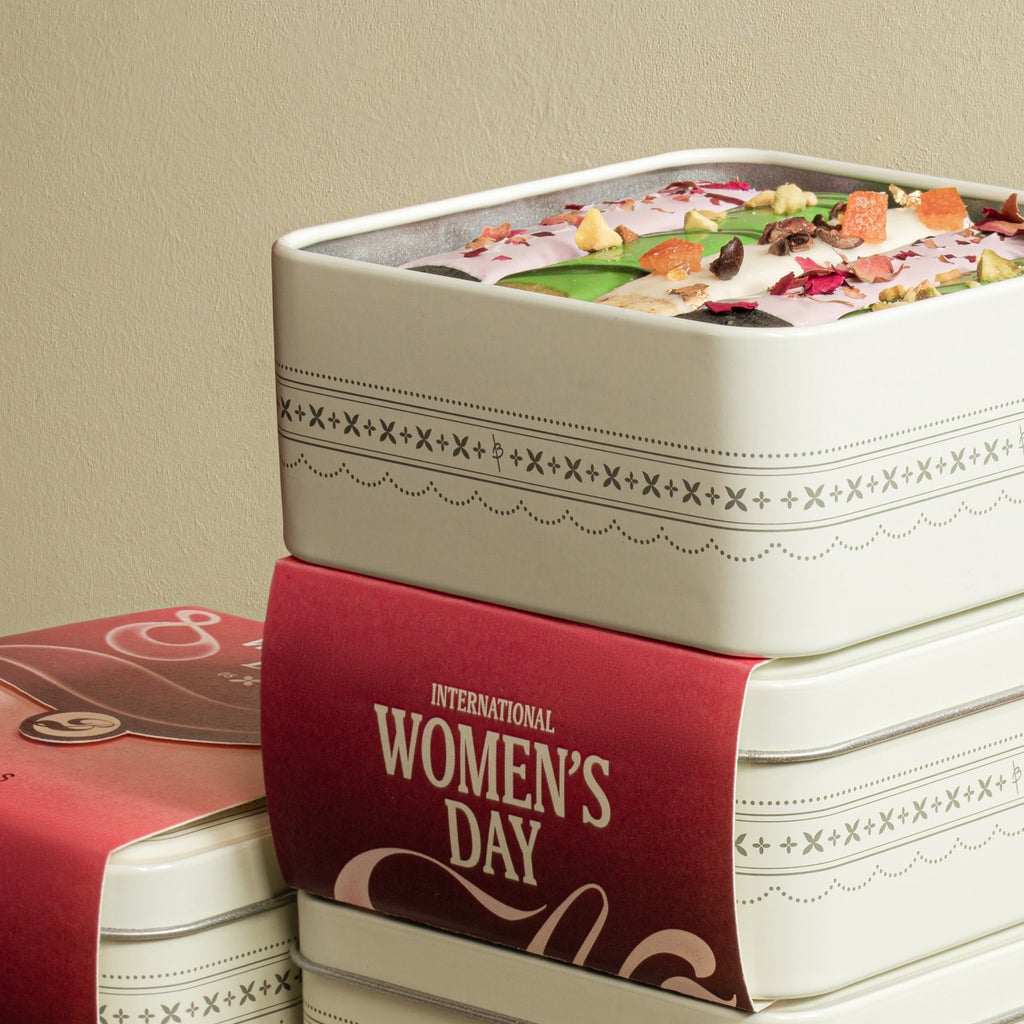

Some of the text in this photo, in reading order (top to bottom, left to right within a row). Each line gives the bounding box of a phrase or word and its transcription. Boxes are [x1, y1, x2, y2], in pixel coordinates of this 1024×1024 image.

[431, 682, 555, 733] INTERNATIONAL
[373, 703, 612, 829] WOMEN'S
[444, 798, 542, 887] DAY
